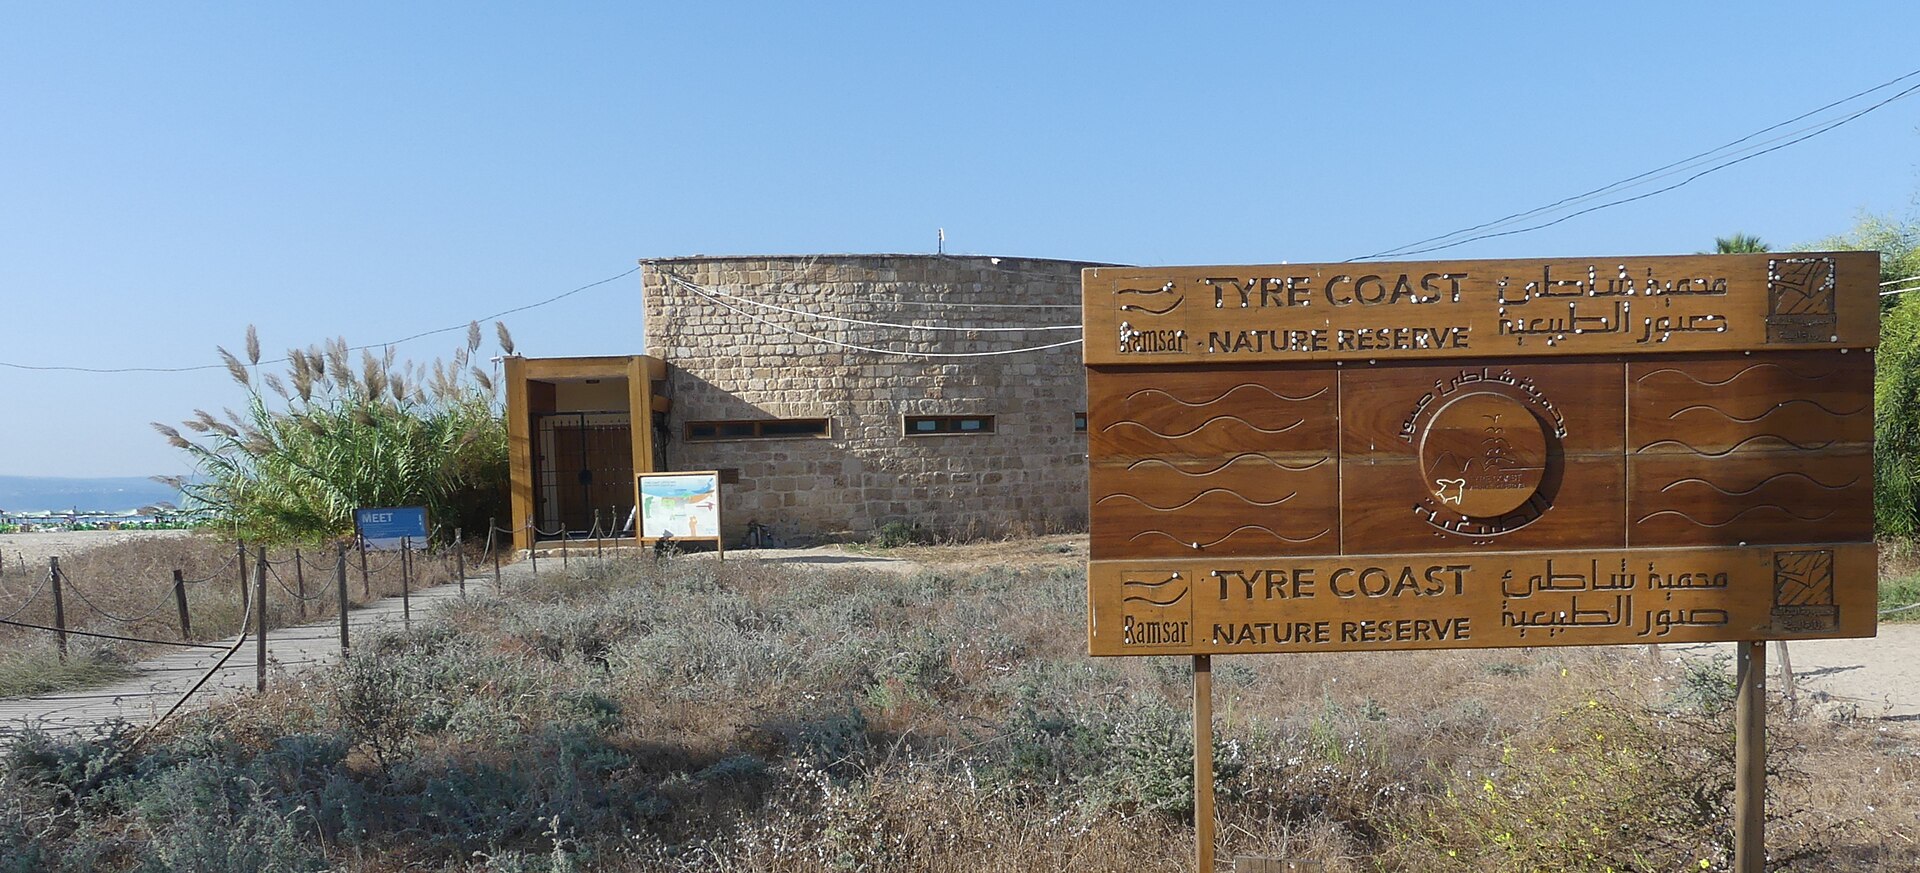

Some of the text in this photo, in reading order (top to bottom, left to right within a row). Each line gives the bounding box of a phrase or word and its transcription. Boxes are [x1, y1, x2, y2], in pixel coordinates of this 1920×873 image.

[1205, 272, 1468, 308] TYRE COAST
[1499, 264, 1728, 307] محمية شاطئ
[1119, 322, 1186, 354] Ramsar
[1209, 326, 1471, 353] NATURE RESERVE
[1499, 301, 1728, 346] صور الطبيعية
[1400, 392, 1437, 443] صور
[1518, 376, 1568, 440] محمية
[362, 513, 393, 523] MEET
[1212, 565, 1472, 601] TYRE COAST
[1501, 558, 1729, 602] محمية شاطئ
[1124, 615, 1189, 645] Ramsar
[1212, 617, 1472, 645] NATURE RESERVE
[1501, 594, 1729, 638] صور الطبيعية
